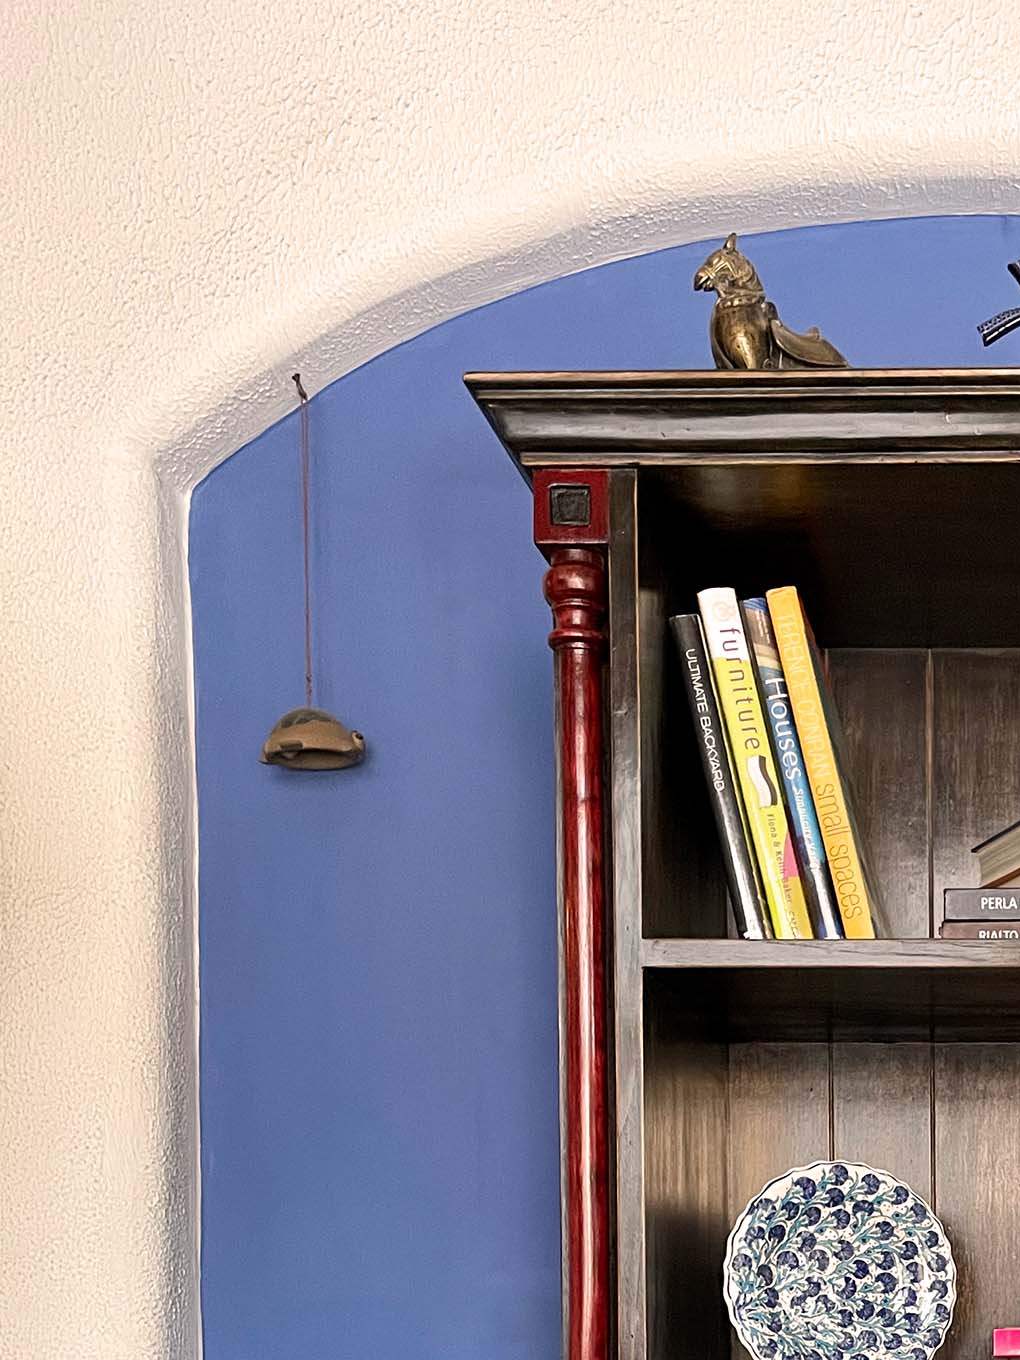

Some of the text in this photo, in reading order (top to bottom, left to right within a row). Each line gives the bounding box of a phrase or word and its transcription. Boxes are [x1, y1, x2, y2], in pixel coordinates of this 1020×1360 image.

[685, 648, 725, 793] ULTIMATE BACKYARD
[719, 627, 760, 749] furniture
[765, 677, 801, 781] Houses
[777, 614, 862, 920] TERENCE CONRAN small spaces
[981, 897, 1017, 910] PERLA
